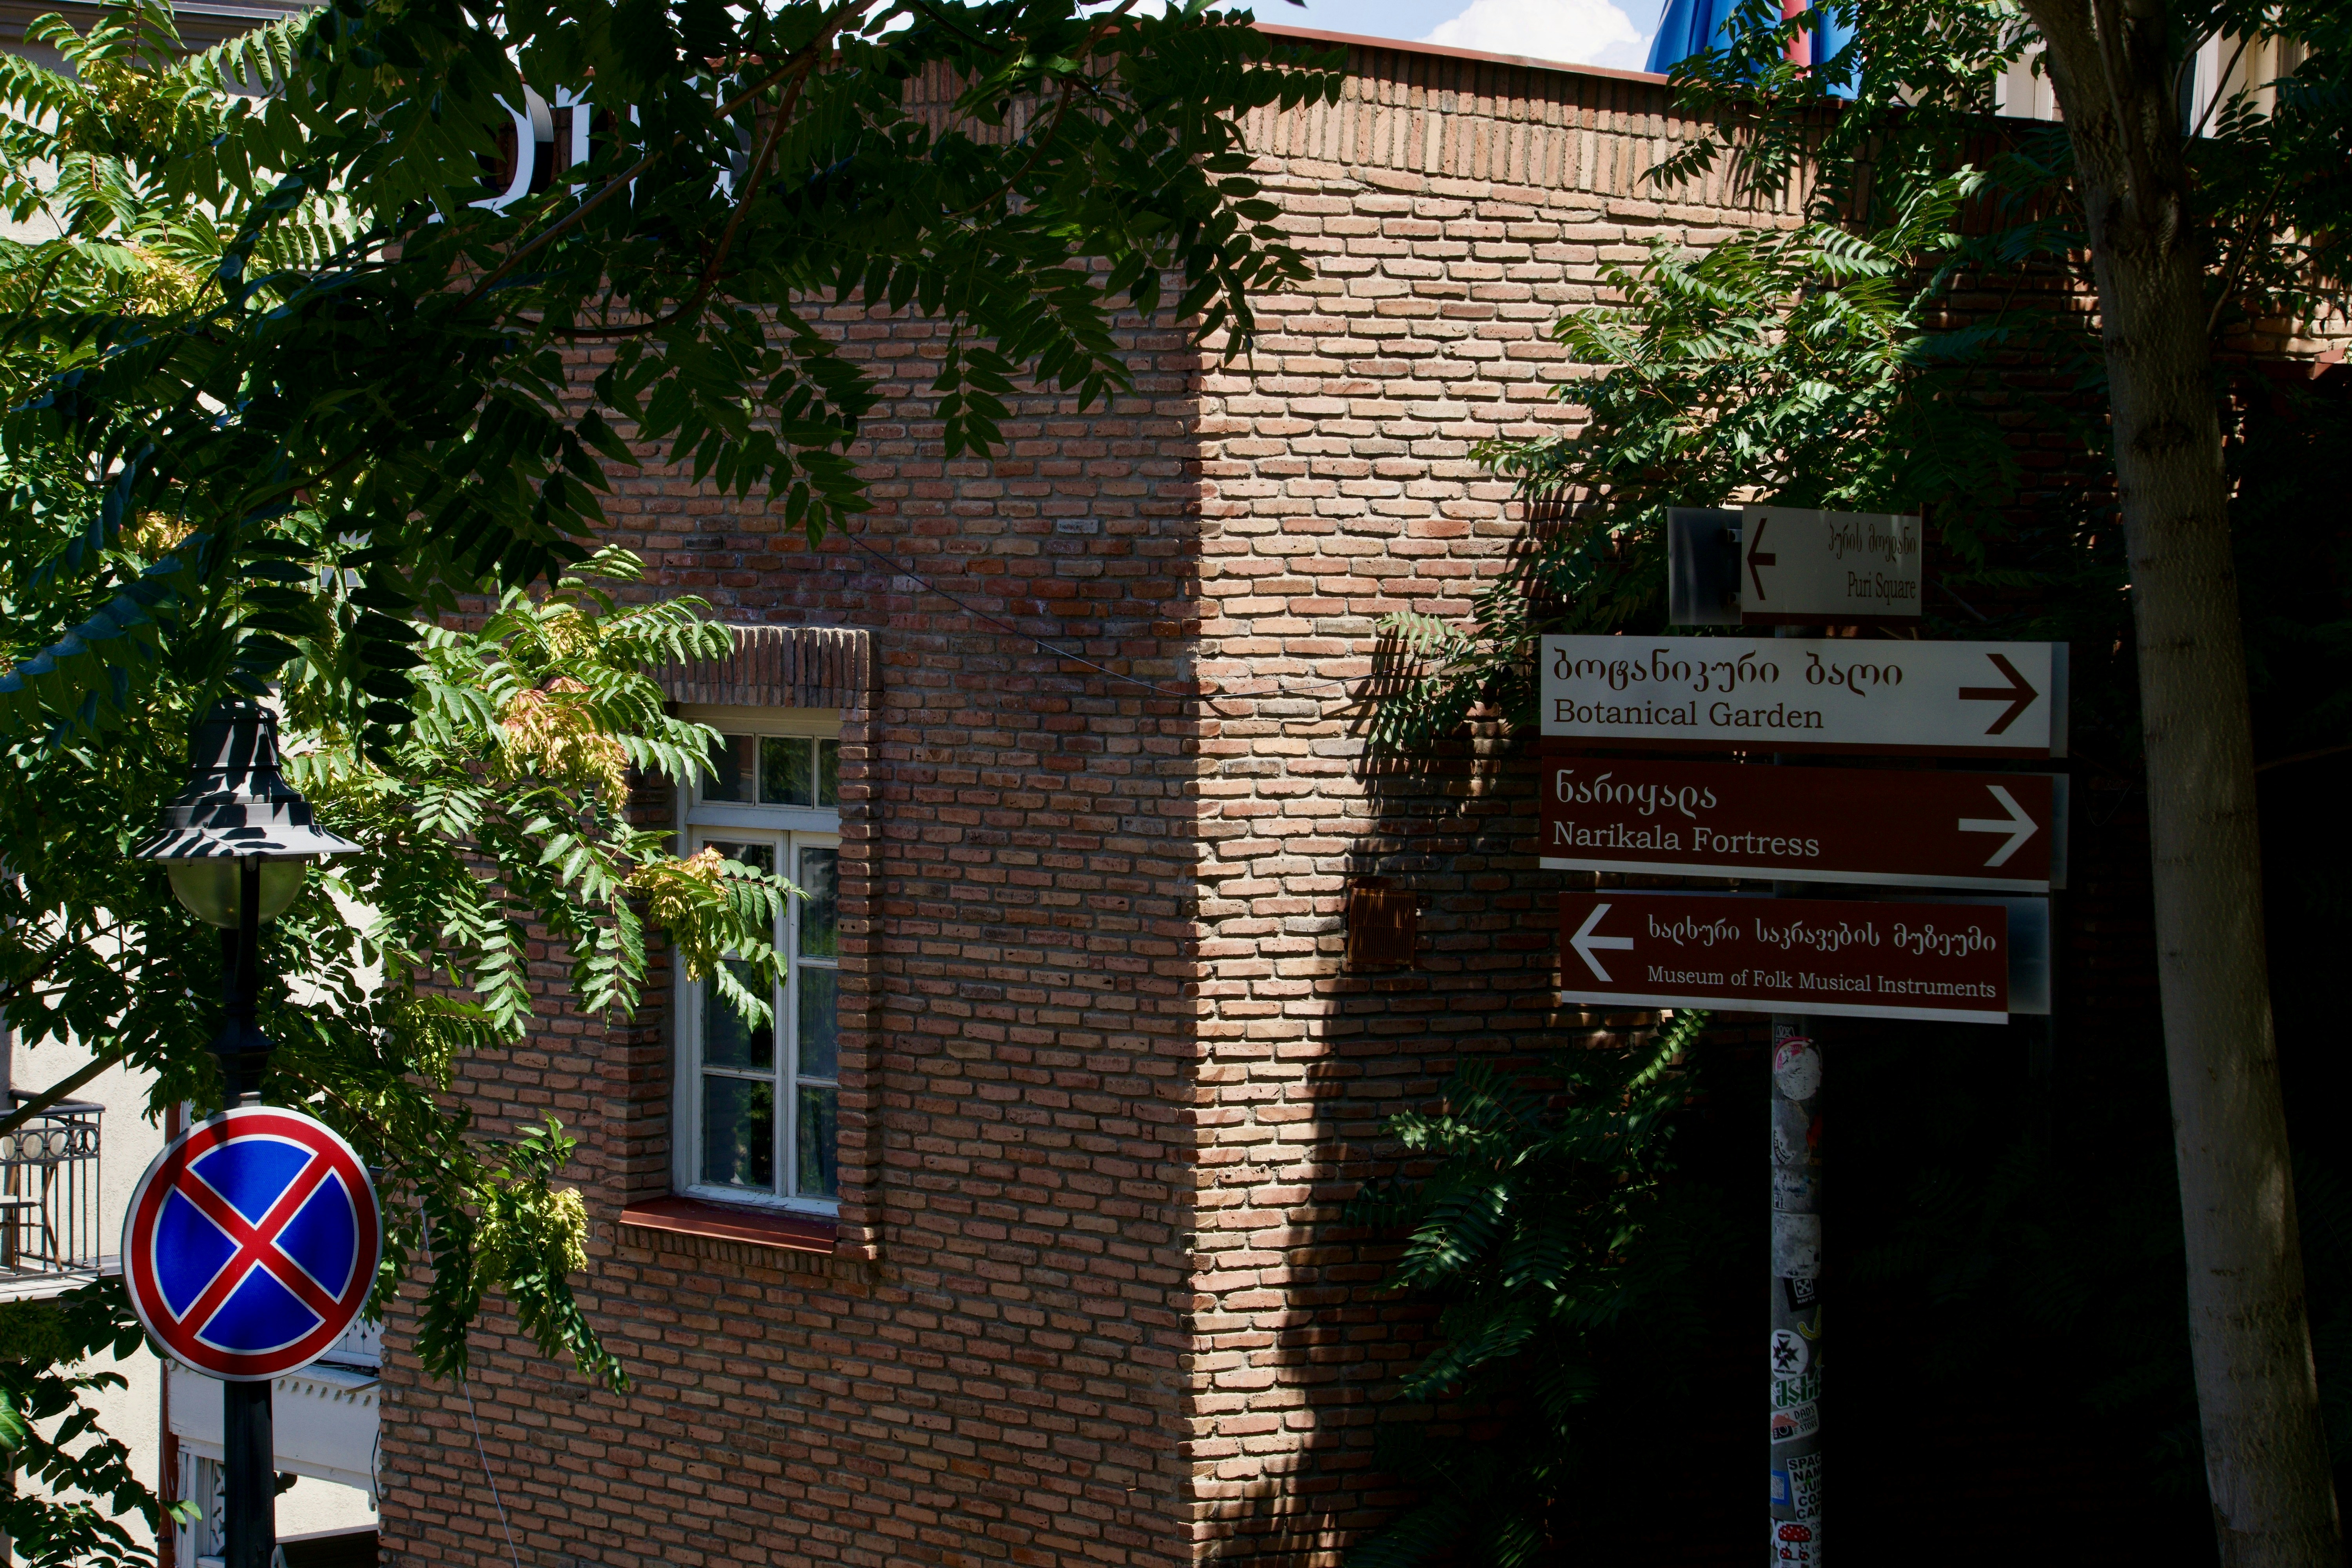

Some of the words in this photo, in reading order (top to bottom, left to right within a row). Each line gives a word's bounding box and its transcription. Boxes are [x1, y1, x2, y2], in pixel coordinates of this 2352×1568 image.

[1828, 521, 1862, 560] პურის
[1868, 523, 1916, 564] მოედანი
[1847, 571, 1872, 598] Puri
[1876, 572, 1916, 606] Square
[1553, 646, 1779, 693] ბოტანიკური
[1806, 650, 1902, 697] ბაღი
[1553, 699, 1698, 726] Botanical
[1709, 702, 1824, 729] Garden
[1556, 769, 1717, 820] ნარიყალა
[1553, 821, 1682, 850] Narikala
[1692, 827, 1819, 857] Fortress
[1648, 914, 1740, 947] ხალხური
[1755, 918, 1880, 951] საკრავების
[1894, 923, 1996, 957] მუზეუმი
[1648, 965, 1724, 985] Museum
[1731, 969, 1749, 986] of
[1753, 970, 1793, 988] Folk
[1798, 972, 1872, 991] Musical
[1877, 976, 1996, 998] Instruments
[1794, 1405, 1815, 1419] DAD'S
[1800, 1419, 1817, 1432] STORE
